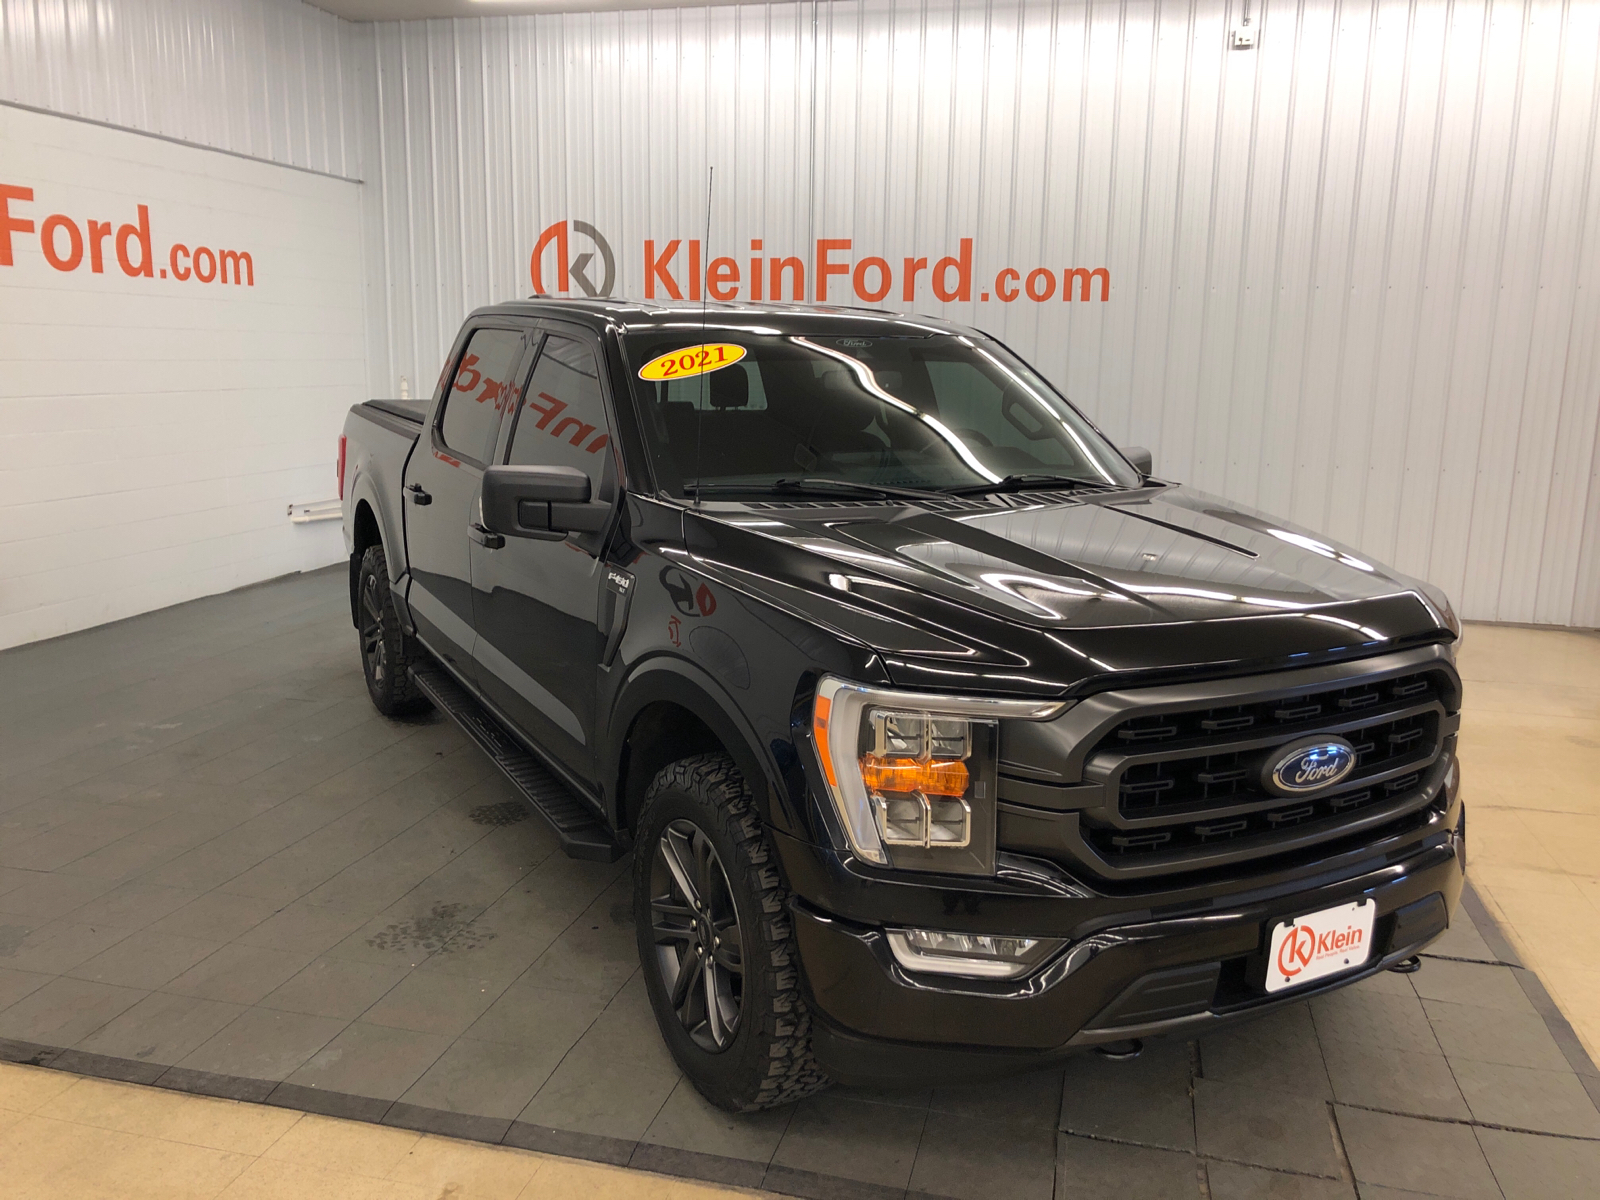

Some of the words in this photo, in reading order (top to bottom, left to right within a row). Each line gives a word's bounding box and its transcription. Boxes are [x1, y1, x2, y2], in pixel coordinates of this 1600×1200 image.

[644, 238, 1110, 303] KleinFord.com
[843, 339, 867, 347] Ford
[661, 346, 728, 377] 2021
[1295, 754, 1339, 783] Ford
[1316, 925, 1363, 954] Klein
